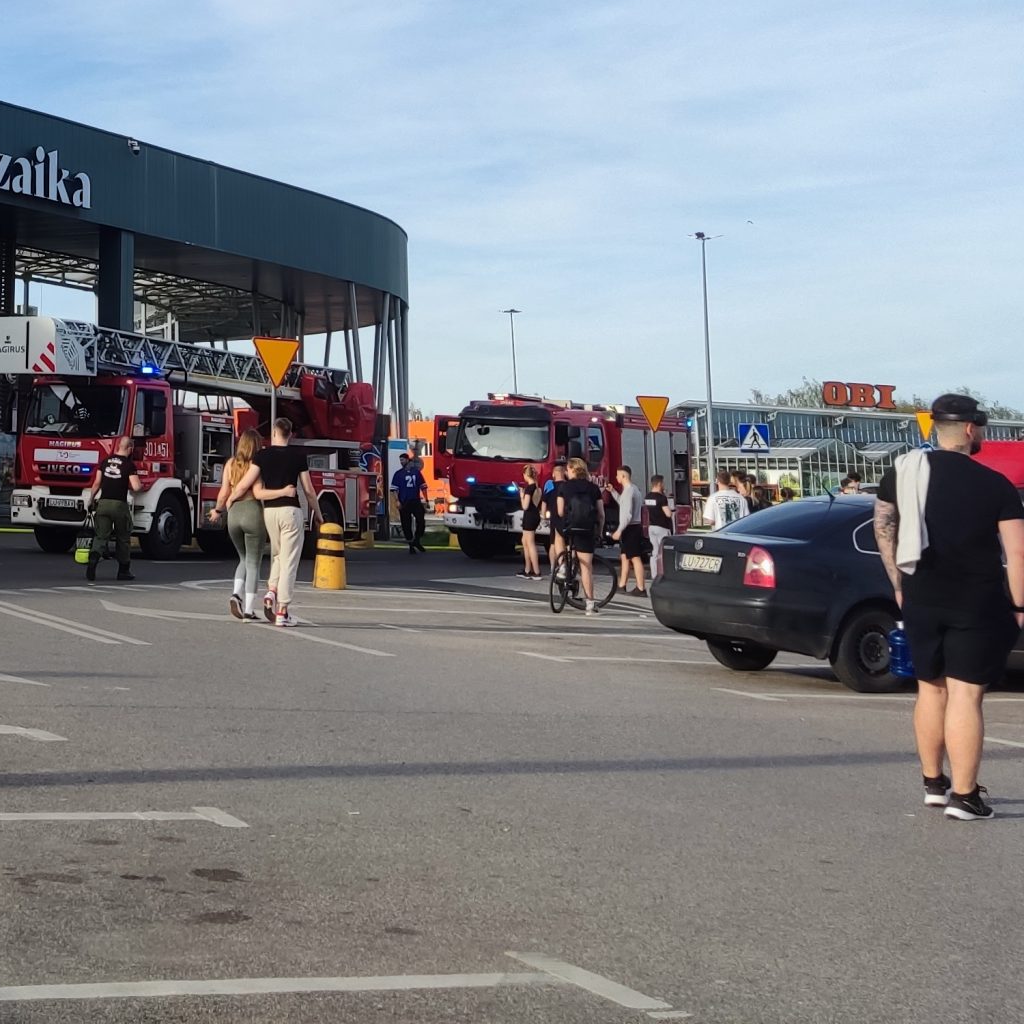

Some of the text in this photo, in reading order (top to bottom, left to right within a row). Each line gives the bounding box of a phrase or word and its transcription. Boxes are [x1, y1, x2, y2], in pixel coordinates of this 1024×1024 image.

[822, 381, 896, 410] OBI
[48, 440, 82, 448] MAGIRUS
[47, 464, 81, 474] IVECO
[683, 555, 693, 567] LU
